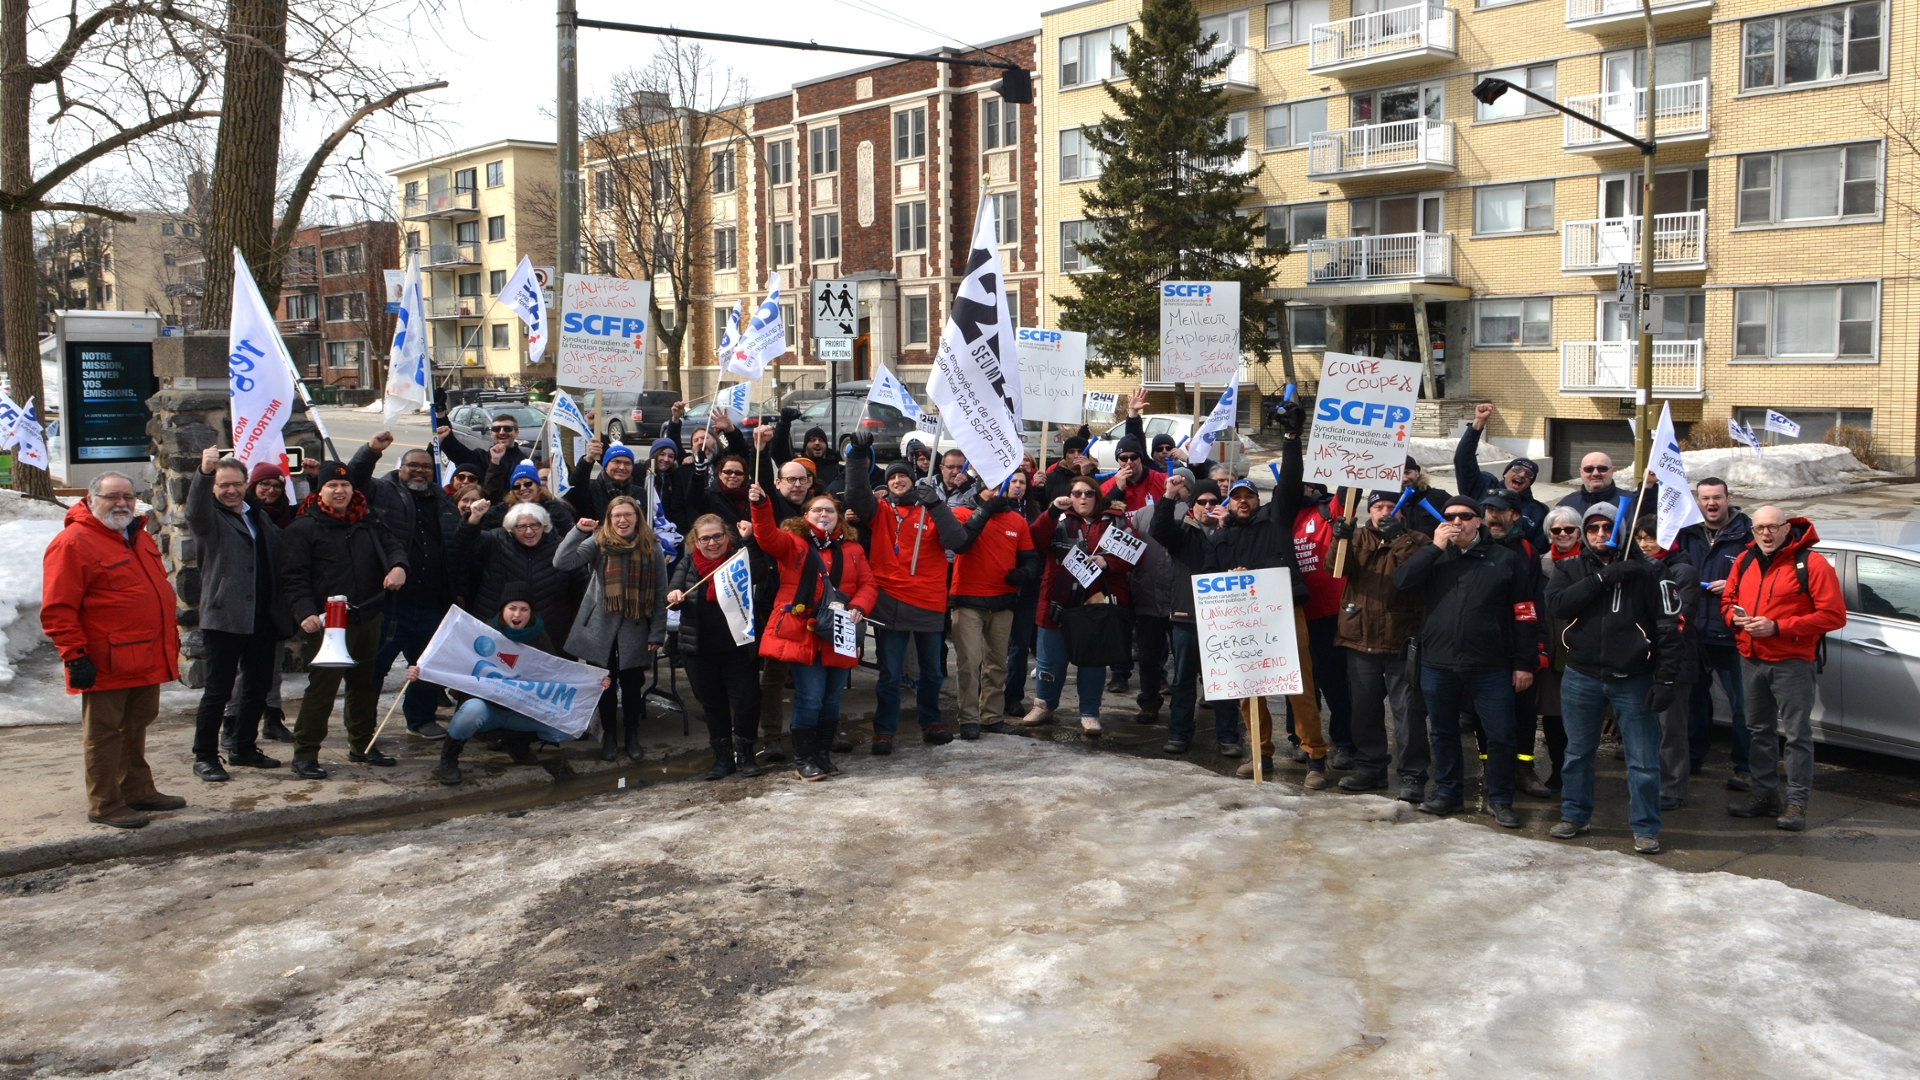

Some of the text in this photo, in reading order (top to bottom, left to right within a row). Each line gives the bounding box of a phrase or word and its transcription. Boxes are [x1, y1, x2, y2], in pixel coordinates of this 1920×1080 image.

[1164, 284, 1212, 297] SCFP
[564, 312, 644, 338] SCFP
[562, 335, 589, 344] Syndicat
[589, 338, 620, 347] canadien
[1019, 330, 1062, 342] SCFP
[569, 342, 597, 352] fonction
[598, 345, 628, 355] publique
[82, 352, 112, 360] NOTRE
[971, 344, 1002, 381] SEUM
[1164, 348, 1191, 364] PAS
[82, 362, 124, 370] MISSION,
[1018, 357, 1082, 381] Employeur
[1163, 365, 1181, 376] NOS
[1328, 360, 1380, 376] COUPE
[82, 371, 119, 379] SAUVER
[83, 380, 102, 388] VOS
[1346, 374, 1398, 393] COUPE
[84, 387, 136, 398] ÉMISSIONS.
[1090, 392, 1114, 402] 1244
[978, 405, 989, 418] de
[1088, 402, 1112, 412] SEUM
[1317, 398, 1410, 428] SCFP
[1314, 424, 1346, 435] Syndicat
[1347, 428, 1380, 439] canadien
[971, 418, 993, 442] SCFP
[995, 448, 1012, 469] FTQ
[1322, 433, 1353, 442] fonction
[1355, 437, 1388, 447] publique
[1314, 463, 1405, 482] AU RECTORAT
[1110, 528, 1142, 551] 1244
[1102, 539, 1136, 563] SEUM
[1066, 559, 1090, 585] SEUM
[1197, 575, 1255, 593] SCFP
[835, 614, 844, 648] 1244
[1210, 668, 1227, 677] AU
[1228, 682, 1239, 690] SA
